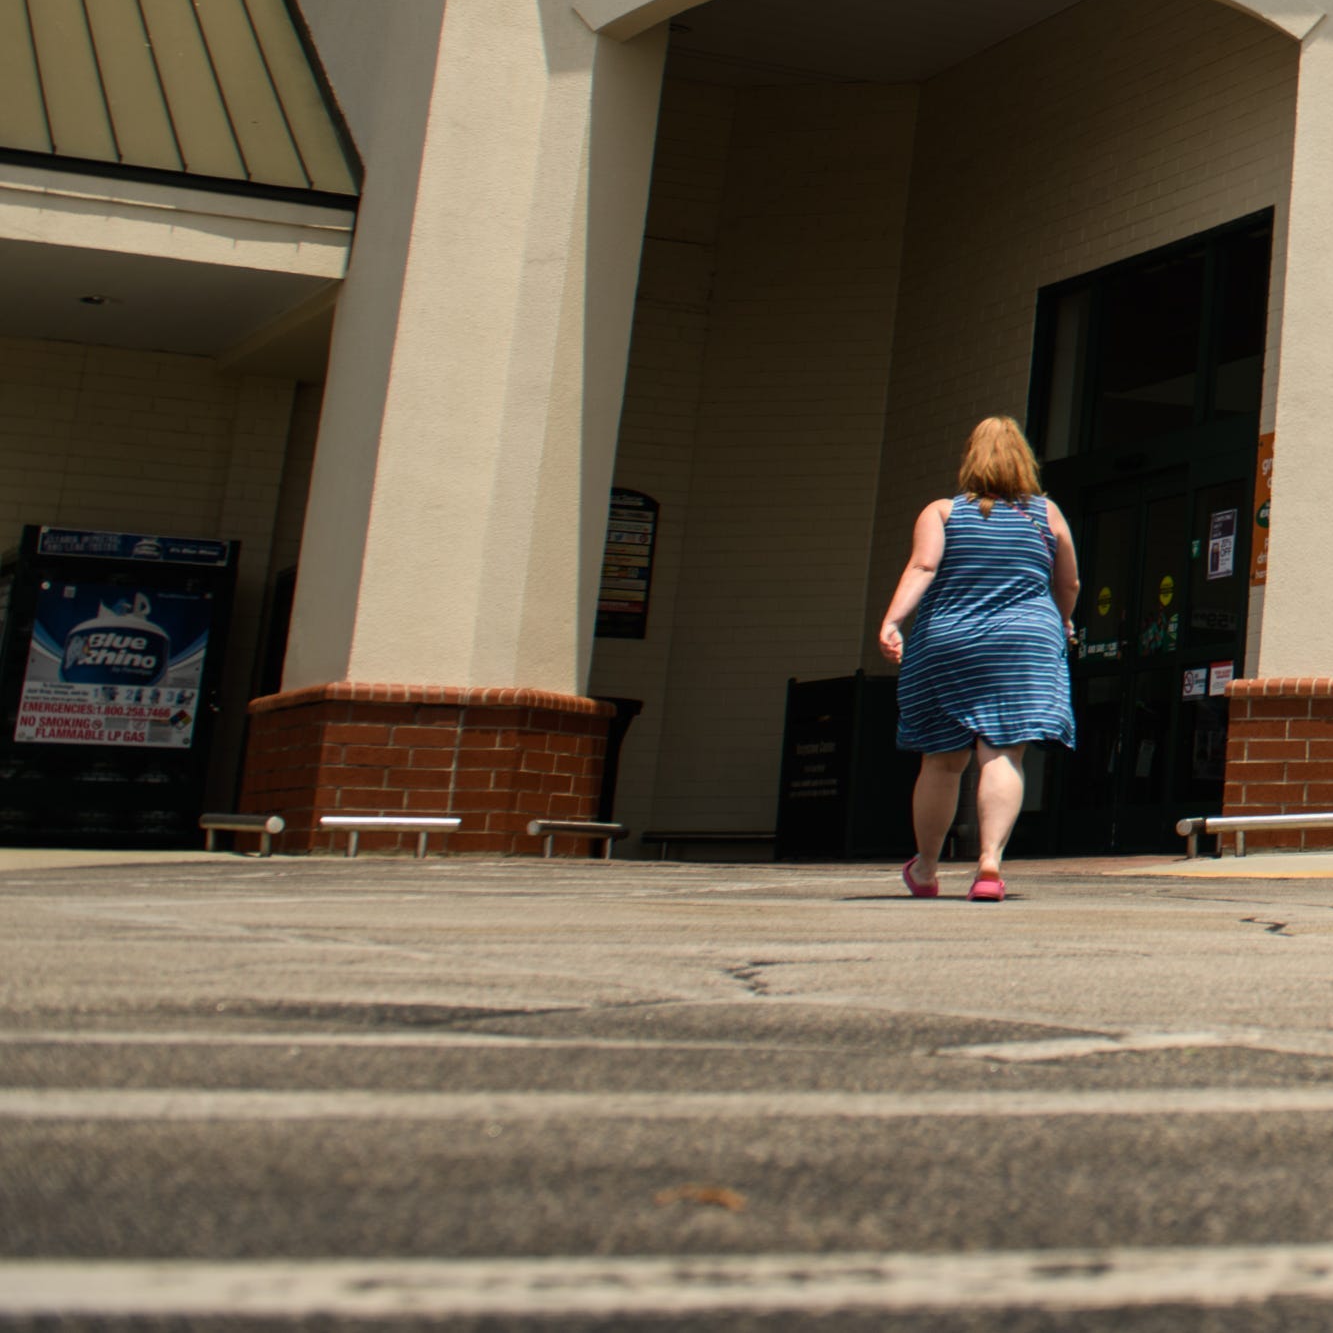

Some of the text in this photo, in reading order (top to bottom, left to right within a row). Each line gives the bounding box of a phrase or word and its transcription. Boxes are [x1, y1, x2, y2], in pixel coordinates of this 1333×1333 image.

[88, 632, 147, 650] Blue
[78, 649, 157, 669] Rhino
[20, 715, 36, 727] NO
[40, 716, 91, 729] SMOKING
[35, 727, 104, 741] FLAMMABLE
[107, 729, 122, 742] LP
[123, 730, 146, 743] GAS
